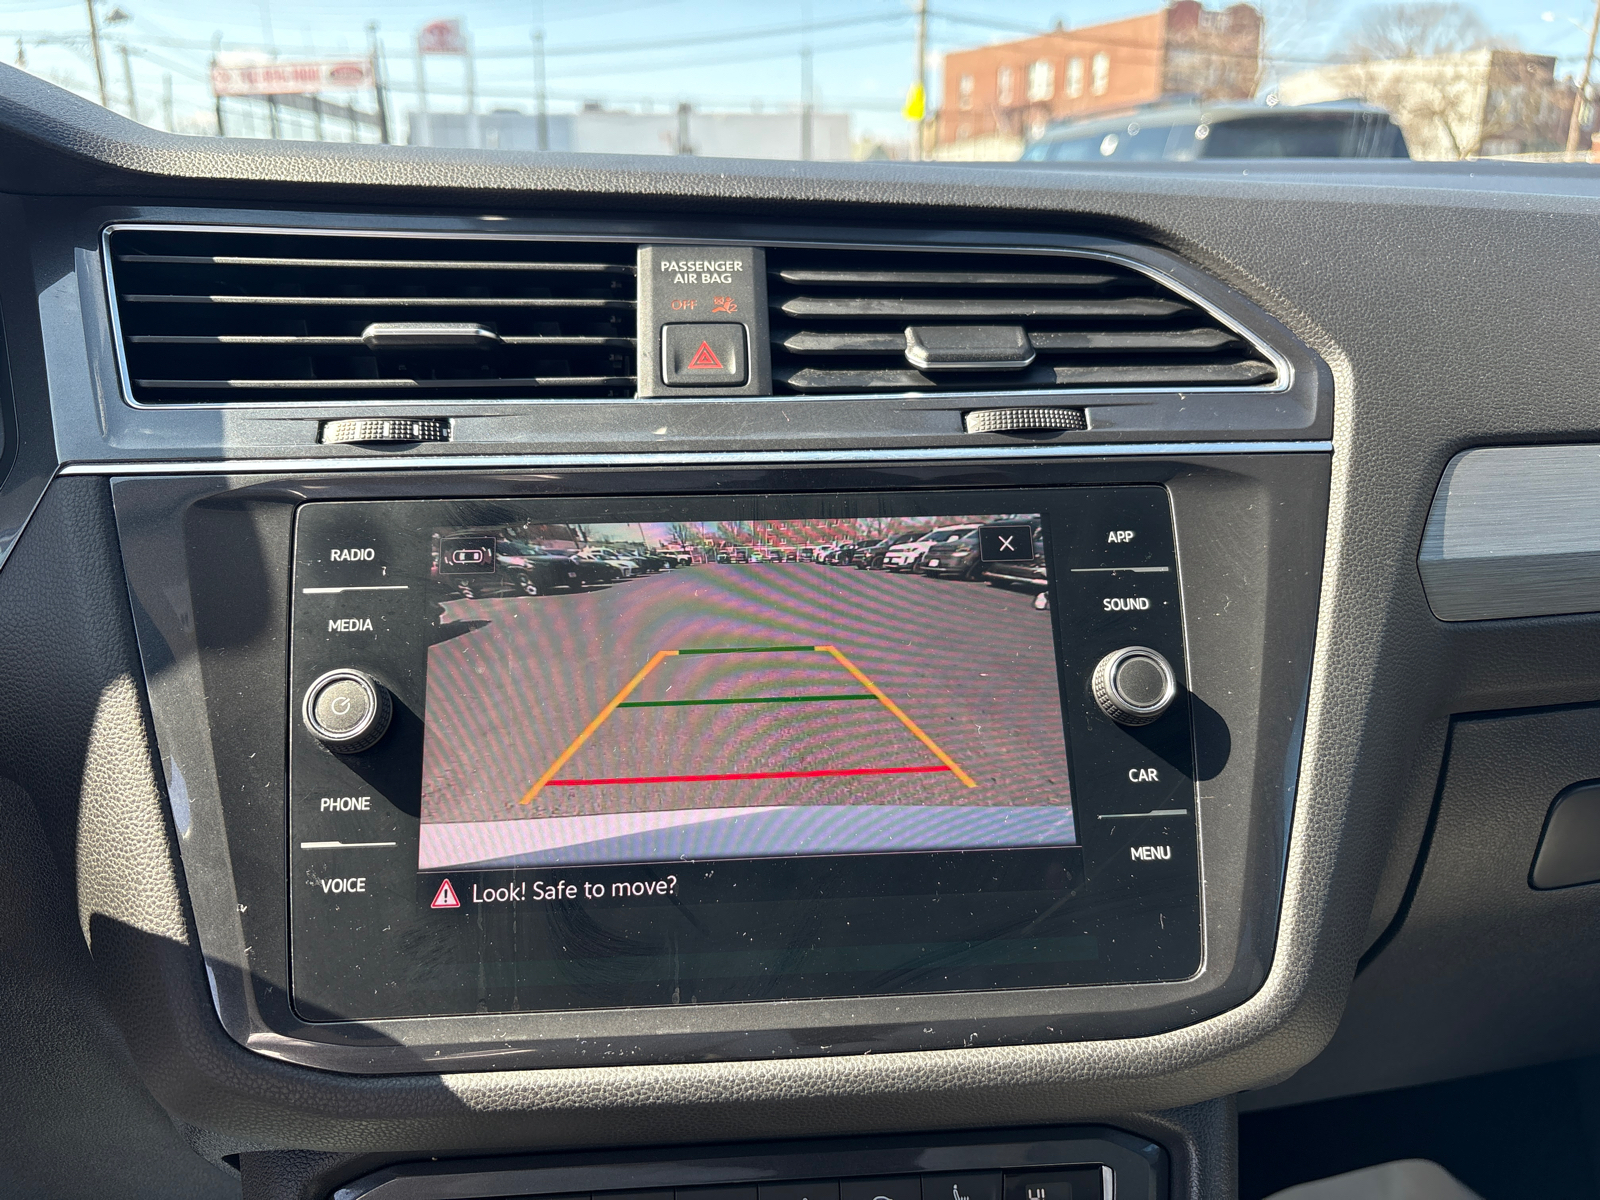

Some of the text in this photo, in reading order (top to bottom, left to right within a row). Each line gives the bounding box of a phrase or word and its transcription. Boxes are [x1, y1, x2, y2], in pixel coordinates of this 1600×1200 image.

[660, 260, 743, 272] PASSENGER
[673, 273, 732, 284] AIR BAG
[670, 299, 698, 311] OFF
[1107, 530, 1134, 543] APP
[330, 547, 375, 562] RADIO
[1102, 597, 1150, 612] SOUND
[327, 618, 374, 633] MEDIA
[1128, 768, 1159, 783] CAR
[320, 796, 371, 812] PHONE
[1130, 845, 1172, 861] MENU
[320, 877, 367, 894] VOICE
[472, 875, 678, 903] Look! Safe to move?
